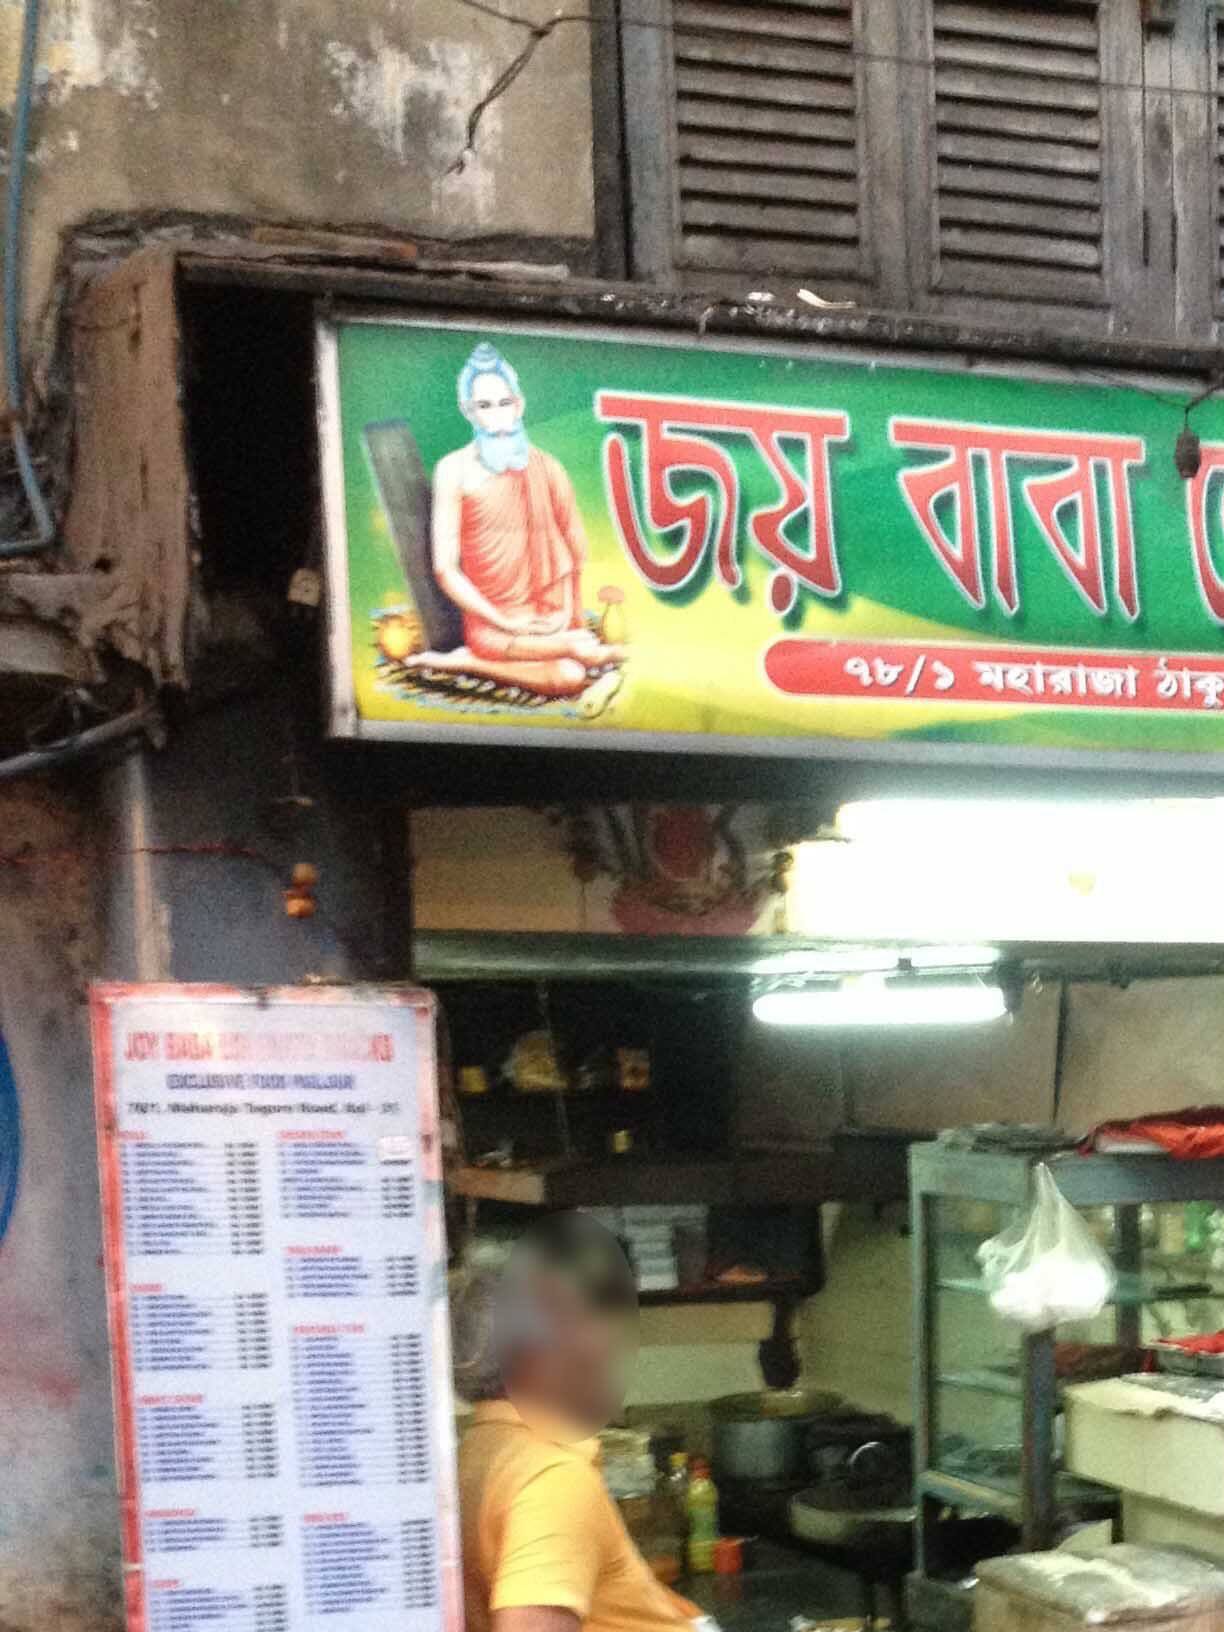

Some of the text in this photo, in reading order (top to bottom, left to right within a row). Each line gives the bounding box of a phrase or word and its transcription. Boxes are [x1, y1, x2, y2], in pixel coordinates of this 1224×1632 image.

[597, 391, 850, 614] জয়
[889, 416, 1145, 622] বাবা
[844, 654, 956, 696] ৭৮/১
[972, 660, 1140, 697] মহারাজা
